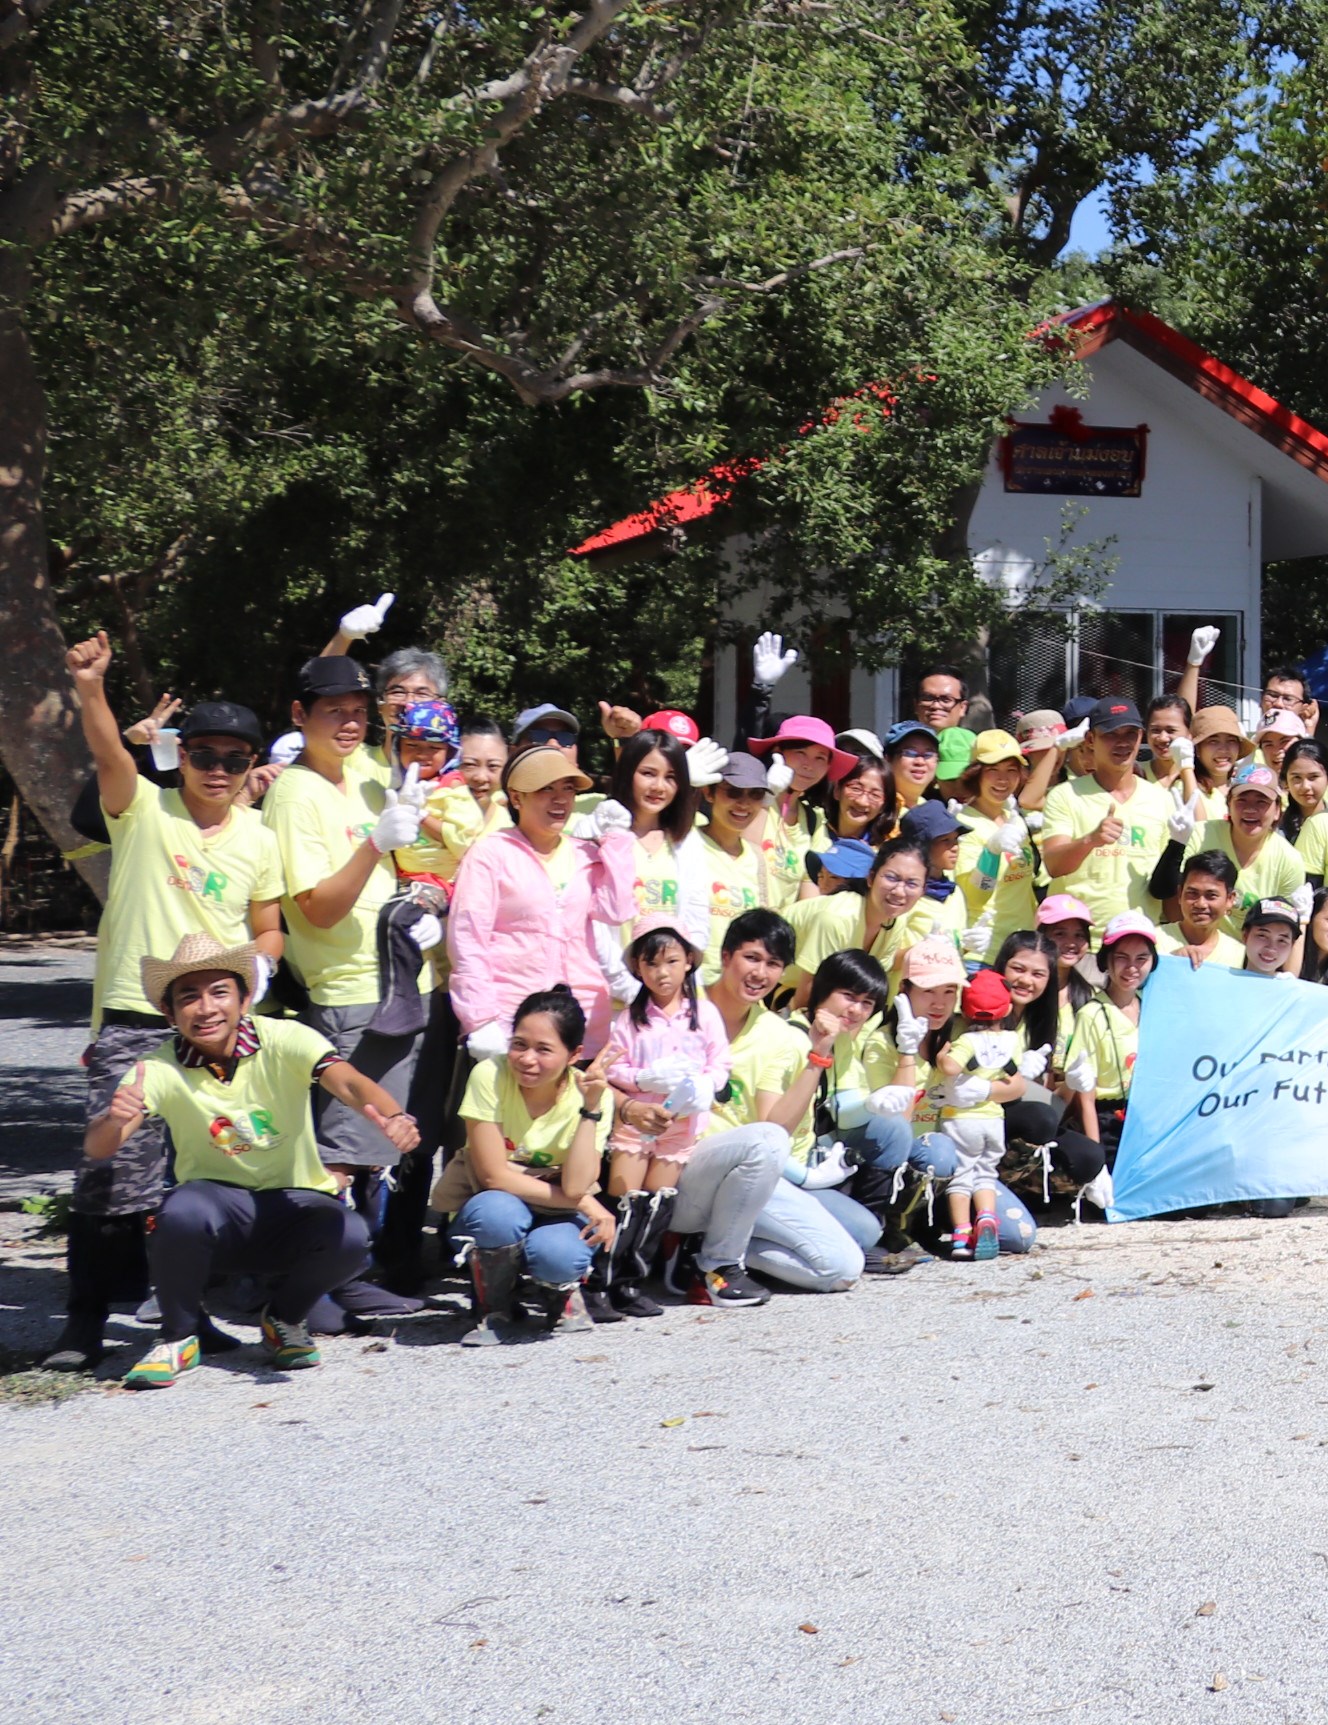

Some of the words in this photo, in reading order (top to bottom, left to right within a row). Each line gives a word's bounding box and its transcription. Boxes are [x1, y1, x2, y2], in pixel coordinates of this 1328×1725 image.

[1119, 825, 1146, 848] SR
[712, 881, 757, 908] CSR
[1198, 1089, 1259, 1117] Our
[209, 1109, 279, 1145] CSR
